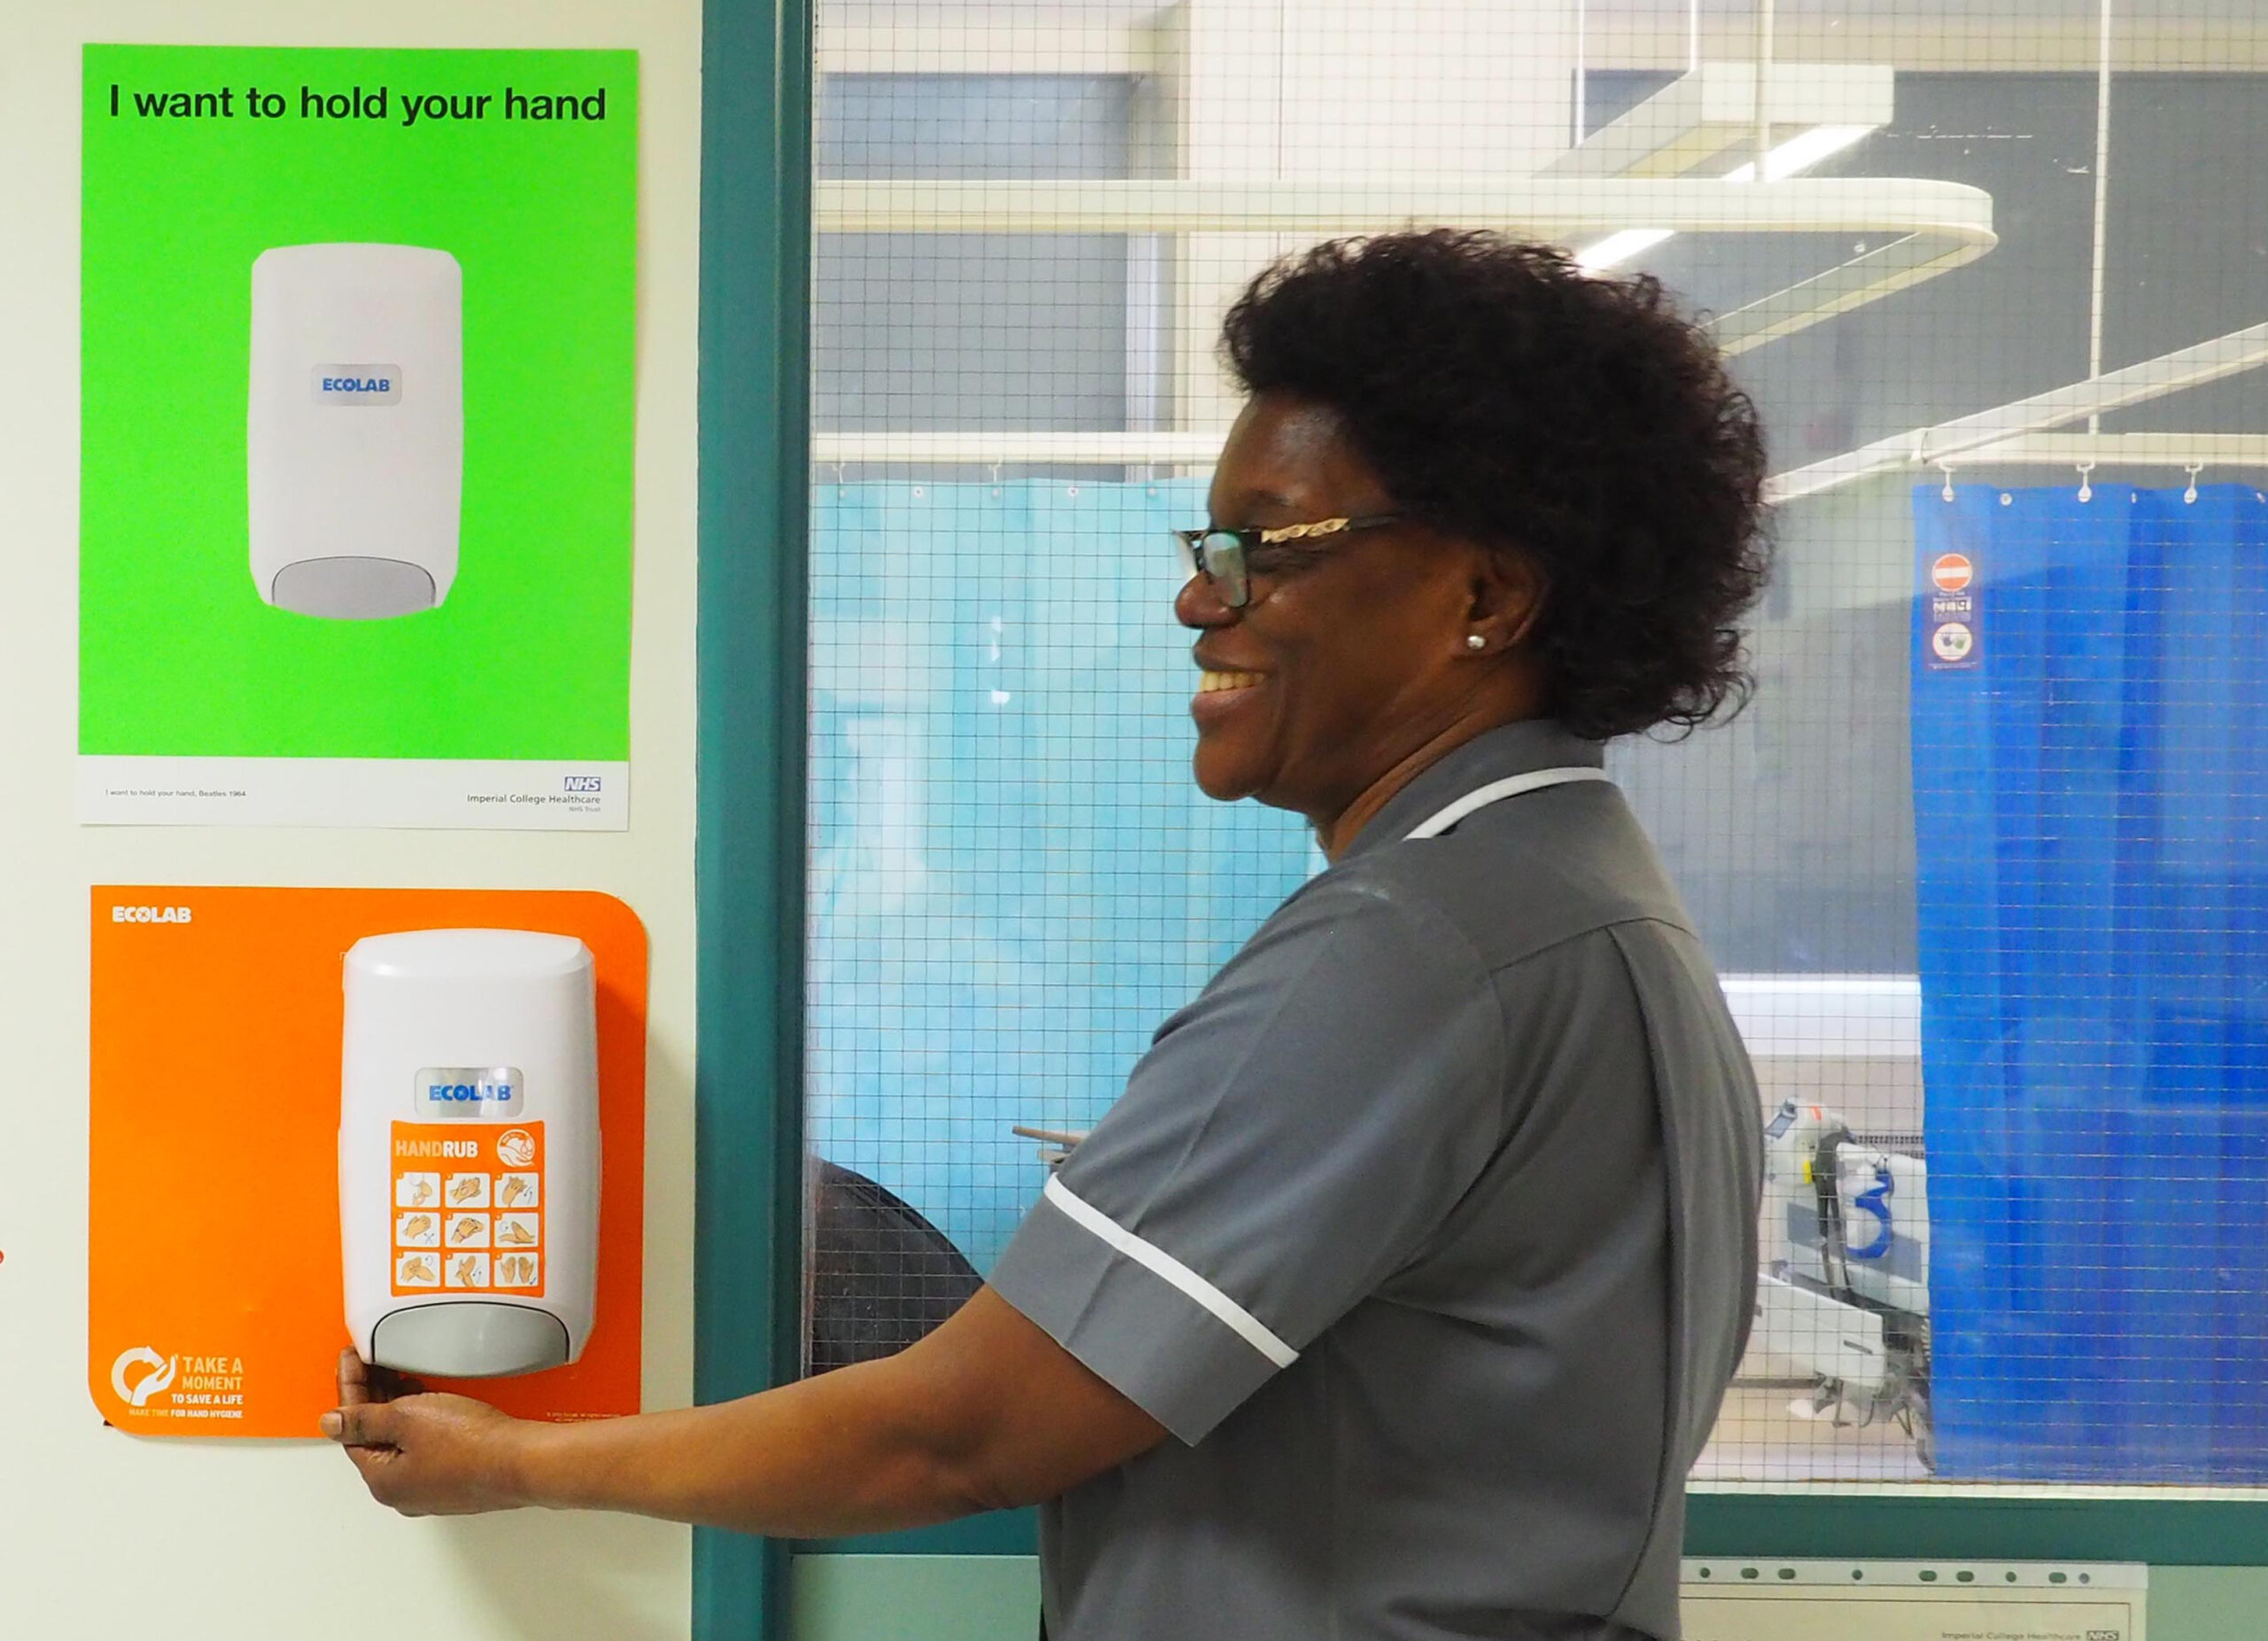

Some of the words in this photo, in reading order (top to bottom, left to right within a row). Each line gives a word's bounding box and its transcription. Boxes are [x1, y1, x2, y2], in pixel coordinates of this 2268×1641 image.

[110, 84, 120, 117] I
[134, 87, 234, 119] want
[247, 87, 286, 120] to
[300, 87, 388, 120] hold
[401, 93, 492, 127] your
[505, 89, 606, 121] hand
[322, 377, 391, 393] ECOLAB
[565, 777, 600, 790] NHS
[467, 794, 507, 805] Imperial
[509, 794, 547, 805] College
[548, 795, 601, 805] Healthcare
[113, 906, 191, 923] ECOLAB
[429, 1085, 511, 1101] ECOLAB
[395, 1139, 478, 1158] HANDRUB
[183, 1357, 228, 1373] TAKE
[231, 1357, 244, 1374] A
[183, 1376, 244, 1390] MOMENT
[171, 1393, 184, 1404] TO
[185, 1394, 212, 1404] SAVE
[213, 1395, 221, 1404] A
[222, 1395, 244, 1405] LIFE
[170, 1409, 186, 1418] FOR
[187, 1409, 209, 1418] HAND
[1941, 1631, 1984, 1640] Imperial
[2086, 1630, 2120, 1641] NHS
